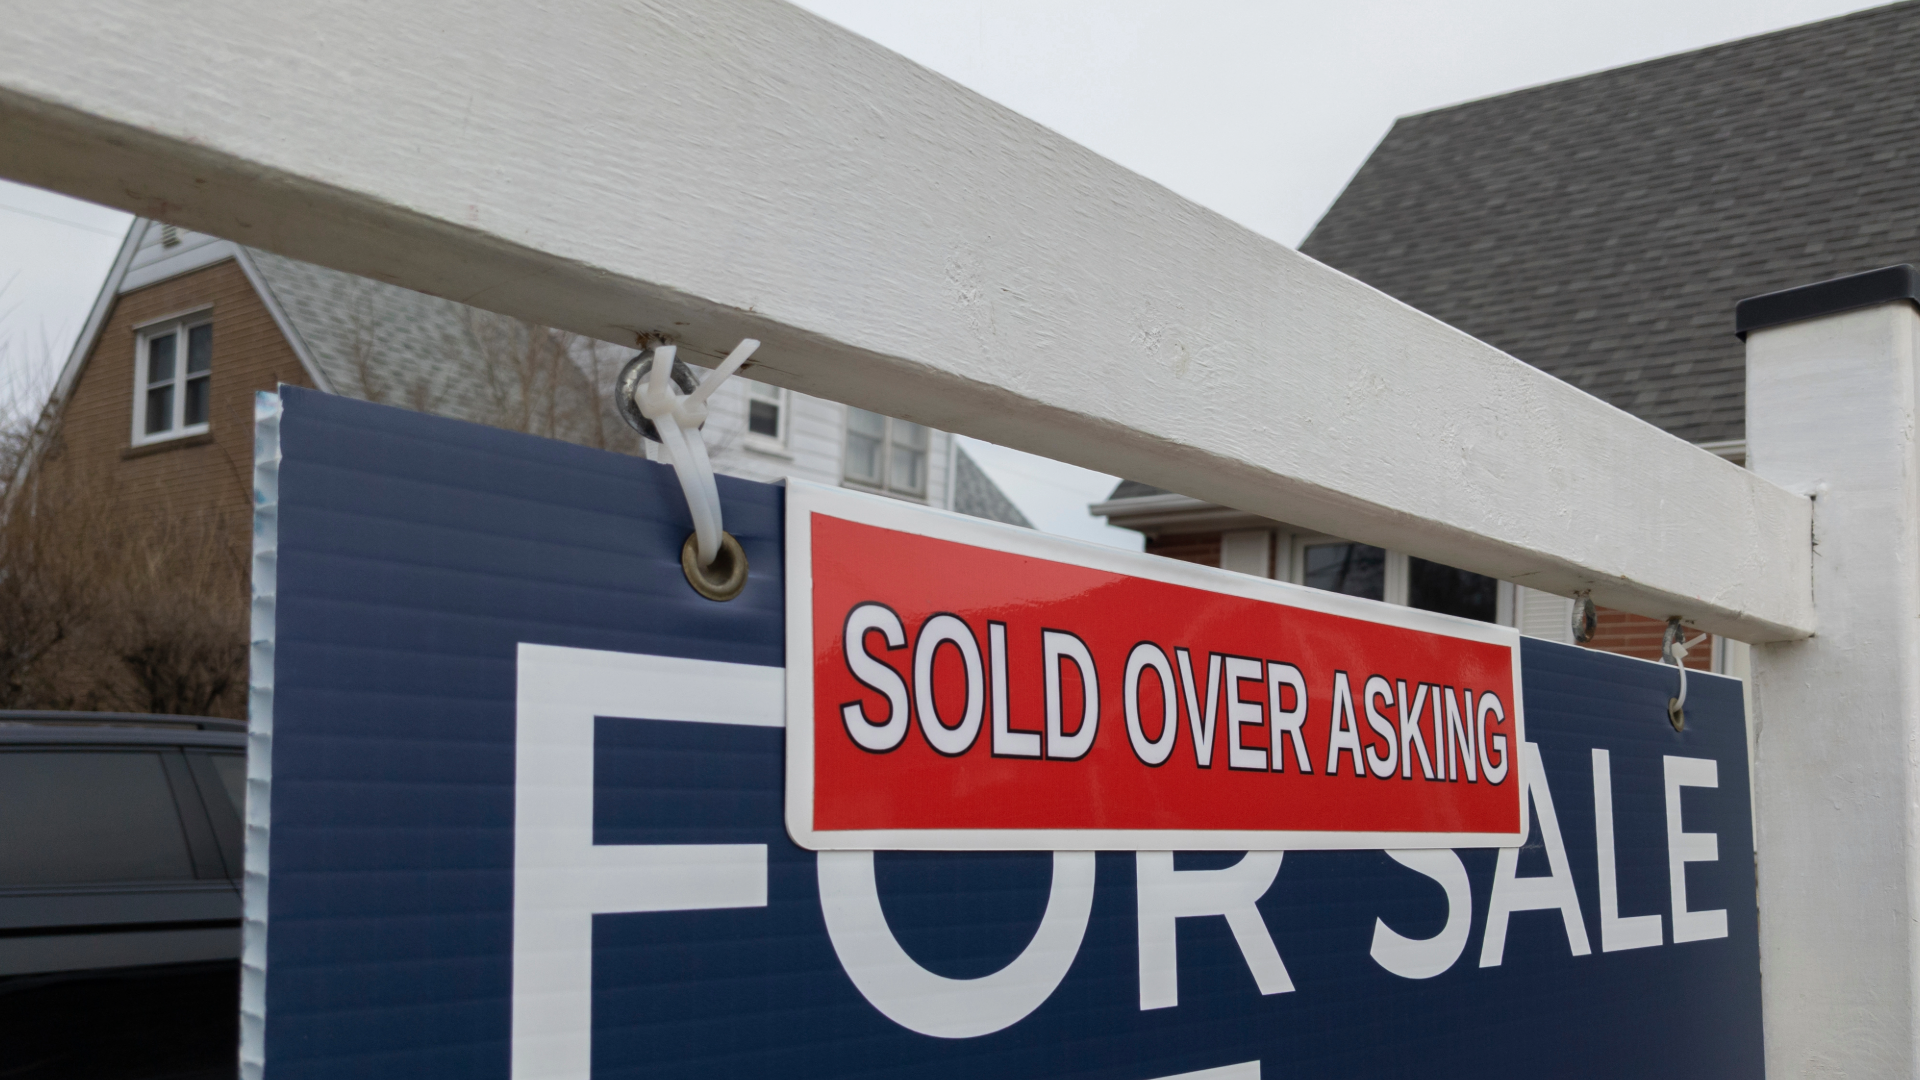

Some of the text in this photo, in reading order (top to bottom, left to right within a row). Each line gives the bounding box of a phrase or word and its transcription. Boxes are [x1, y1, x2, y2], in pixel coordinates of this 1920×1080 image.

[840, 600, 1509, 785] SOLD OVER ASKING
